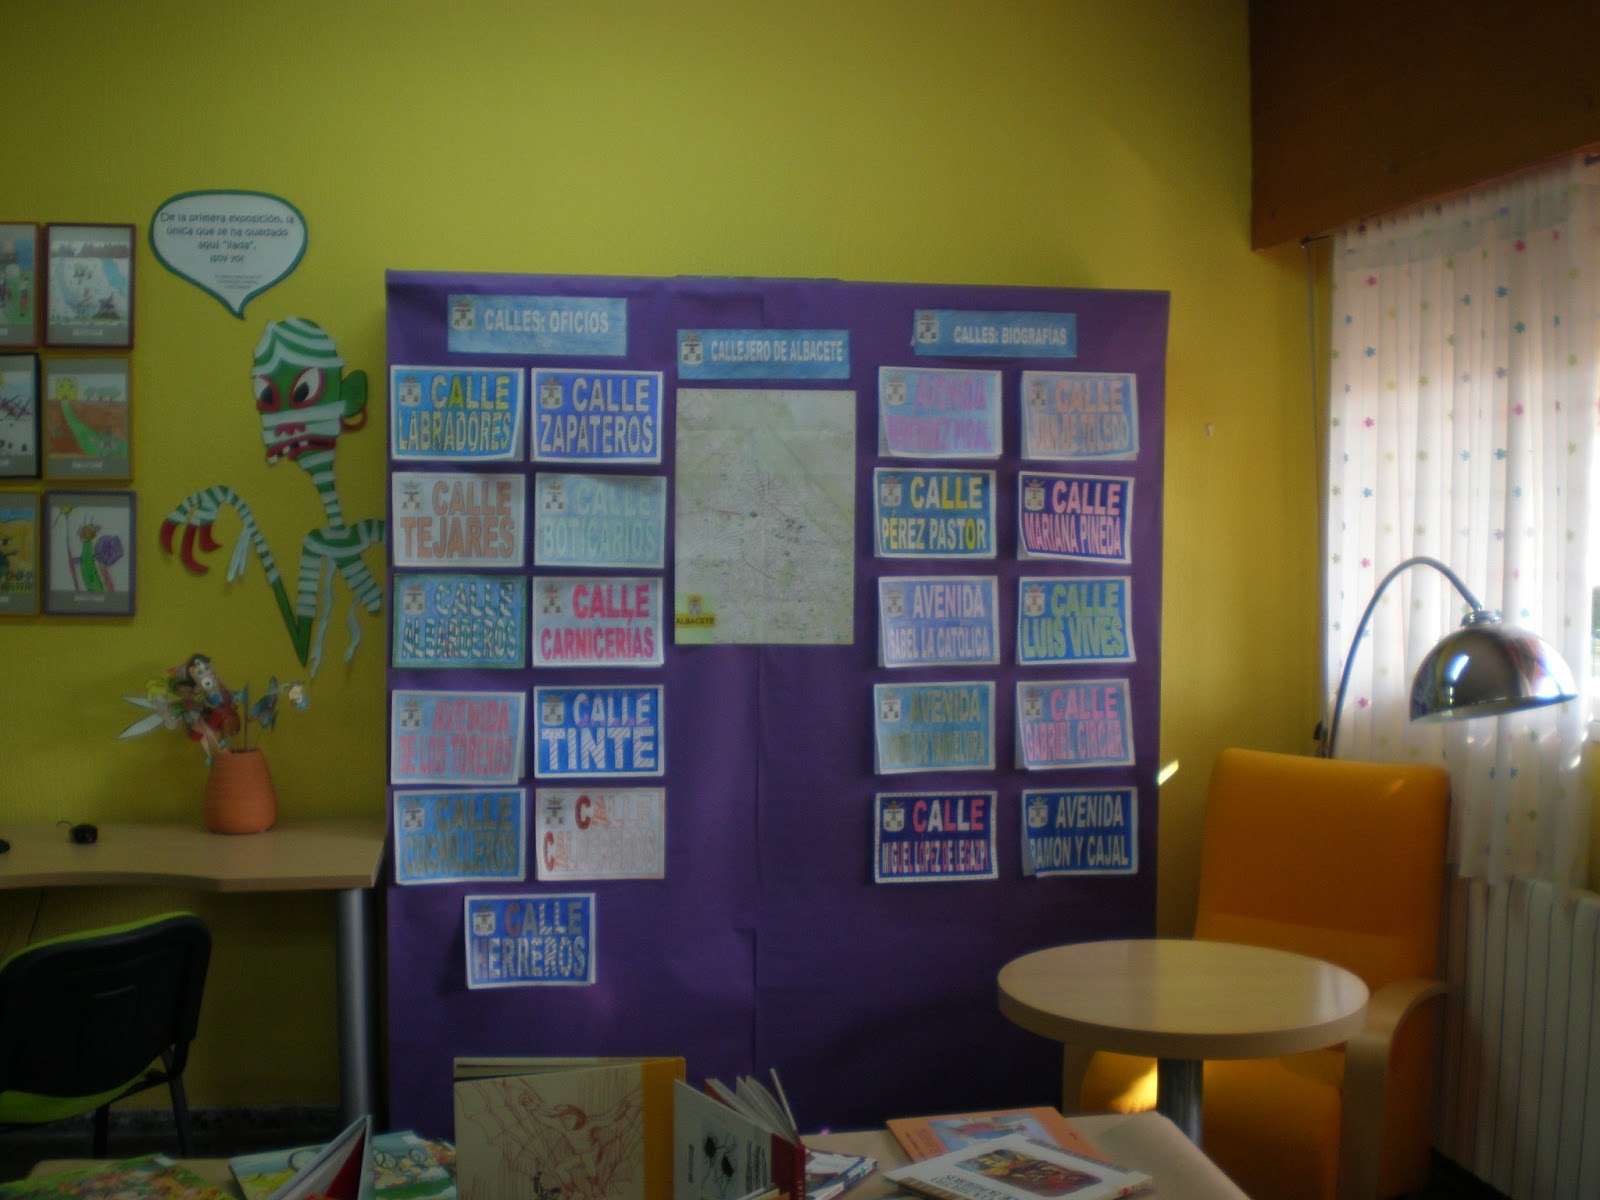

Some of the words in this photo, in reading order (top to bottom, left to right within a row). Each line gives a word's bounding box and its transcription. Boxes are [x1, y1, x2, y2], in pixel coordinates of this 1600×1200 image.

[161, 212, 175, 222] De
[178, 214, 186, 222] la
[189, 214, 226, 224] primera
[196, 228, 214, 236] que
[218, 228, 226, 236] se
[231, 228, 242, 236] ha
[245, 228, 288, 237] quedado
[550, 310, 608, 334] OFICIOS
[954, 326, 998, 344] CALLES:
[711, 340, 771, 361] CALLEJERO
[774, 340, 786, 361] DE
[790, 340, 843, 362] ALBACETE
[430, 374, 510, 410] CALLE
[572, 377, 650, 412] CALLE
[1056, 379, 1123, 412] CALLE
[399, 409, 511, 451] LABRADORES
[541, 414, 653, 454] ZAPATEROS
[431, 481, 512, 516] CALLE
[574, 482, 653, 517] CALLE
[910, 476, 982, 509] CALLE
[1052, 480, 1121, 515] CALLE
[399, 516, 515, 558] TEJARES
[930, 517, 987, 550] PASTOR
[1024, 512, 1079, 553] MARIANA
[1081, 514, 1122, 556] PINEDA
[435, 582, 514, 617] CALLE
[572, 583, 650, 619] CALLE
[913, 584, 985, 618] AVENIDA
[1050, 583, 1119, 618] CALLE
[676, 617, 714, 625] ALBACETE
[1023, 616, 1066, 658] LUIS
[1068, 615, 1125, 658] VIVES
[922, 627, 935, 658] LA
[432, 700, 510, 732] AVENIDA
[573, 692, 651, 726] CALLE
[1050, 687, 1117, 720] CALLE
[541, 727, 654, 770] TINTE
[435, 797, 512, 832] CALLE
[575, 794, 650, 830] CALLE
[913, 800, 984, 832] CALLE
[1056, 795, 1124, 828] AVENIDA
[942, 840, 953, 872] DE
[1075, 836, 1083, 866] Y
[1087, 835, 1128, 866] CAJAL
[504, 901, 582, 936] CALLE
[473, 936, 585, 978] HERREROS
